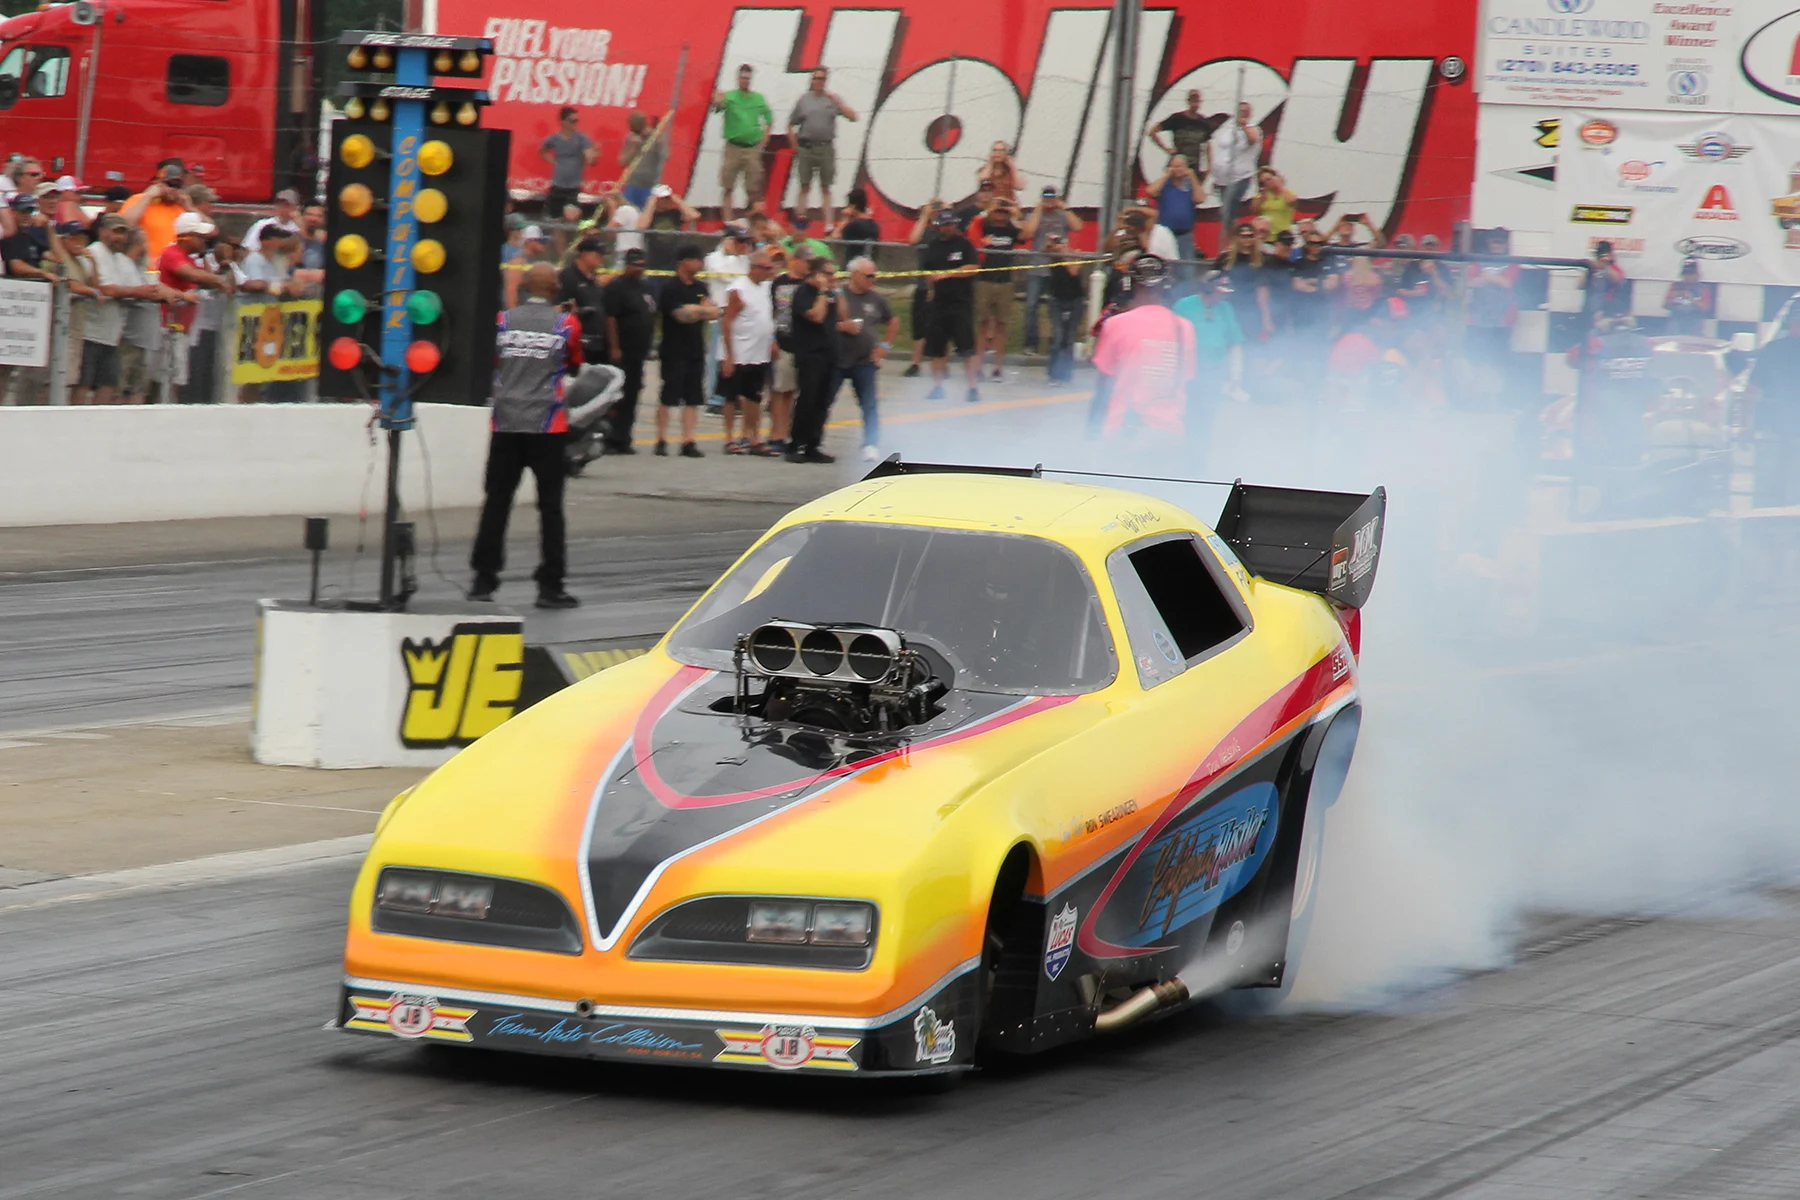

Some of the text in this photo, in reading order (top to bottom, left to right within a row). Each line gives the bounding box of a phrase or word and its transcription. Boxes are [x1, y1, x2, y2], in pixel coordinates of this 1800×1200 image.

[1653, 4, 1732, 16] Excellence
[484, 17, 612, 62] FUEL YOUR
[1487, 16, 1650, 39] CANDLEWOOD
[1668, 20, 1715, 31] Award
[1496, 59, 1546, 72] (270)
[1523, 45, 1612, 57] SUITES
[379, 86, 436, 99] STAGE
[488, 57, 648, 108] PASSION!
[683, 7, 1436, 238] Holley
[386, 135, 417, 329] COMPULINK
[1203, 806, 1269, 893] Hustler
[487, 1012, 703, 1049] Team Auto Collision
